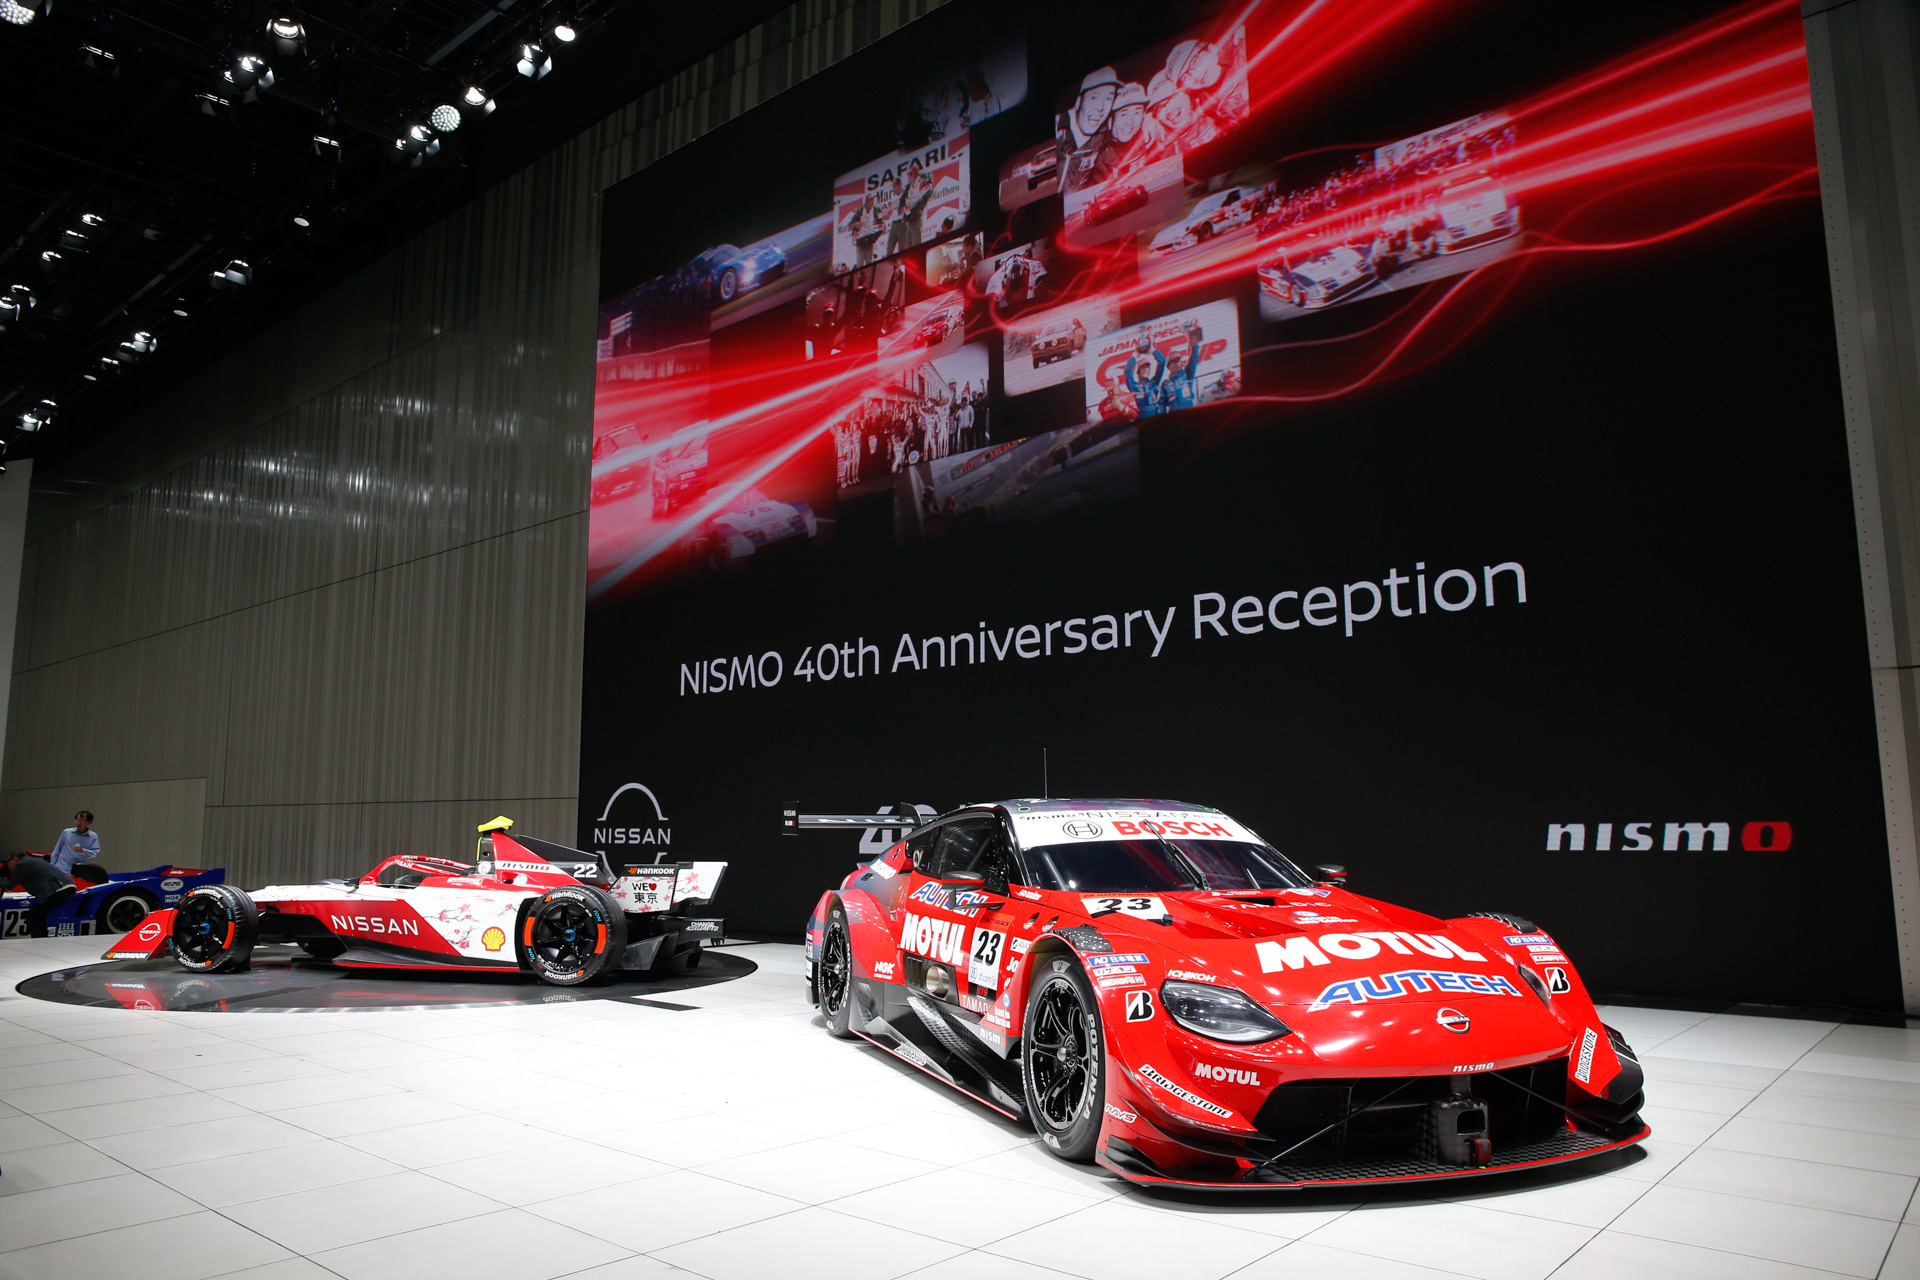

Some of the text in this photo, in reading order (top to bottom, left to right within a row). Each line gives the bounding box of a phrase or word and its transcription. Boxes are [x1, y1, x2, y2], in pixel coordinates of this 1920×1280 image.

[867, 144, 946, 192] SAFARI
[679, 561, 1527, 697] NISMO 40th Anniversary Reception
[1085, 811, 1187, 819] NISSAN
[594, 828, 671, 845] NISSAN
[1111, 820, 1234, 837] BOSCH
[1546, 821, 1793, 851] nismo
[502, 861, 550, 871] nismo
[573, 864, 598, 878] 22
[632, 883, 649, 891] WE
[633, 892, 658, 904] 東京
[1097, 898, 1152, 911] 23
[330, 914, 419, 936] NISSAN
[900, 912, 967, 966] MOTUL
[974, 930, 1001, 966] 23
[1254, 931, 1488, 974] MOTUL
[874, 960, 895, 975] NGK
[1167, 969, 1217, 983] ICHIKOH
[1306, 968, 1523, 1012] AUTECH
[980, 1028, 1007, 1048] nismo
[1576, 1028, 1598, 1084] BRIDGESTONE
[1083, 1013, 1099, 1121] POTENZA
[1194, 1062, 1261, 1087] MOTUL
[1452, 1062, 1495, 1073] nismo
[1139, 1064, 1233, 1118] BRIDGESTONE
[1105, 1103, 1138, 1123] RAYS
